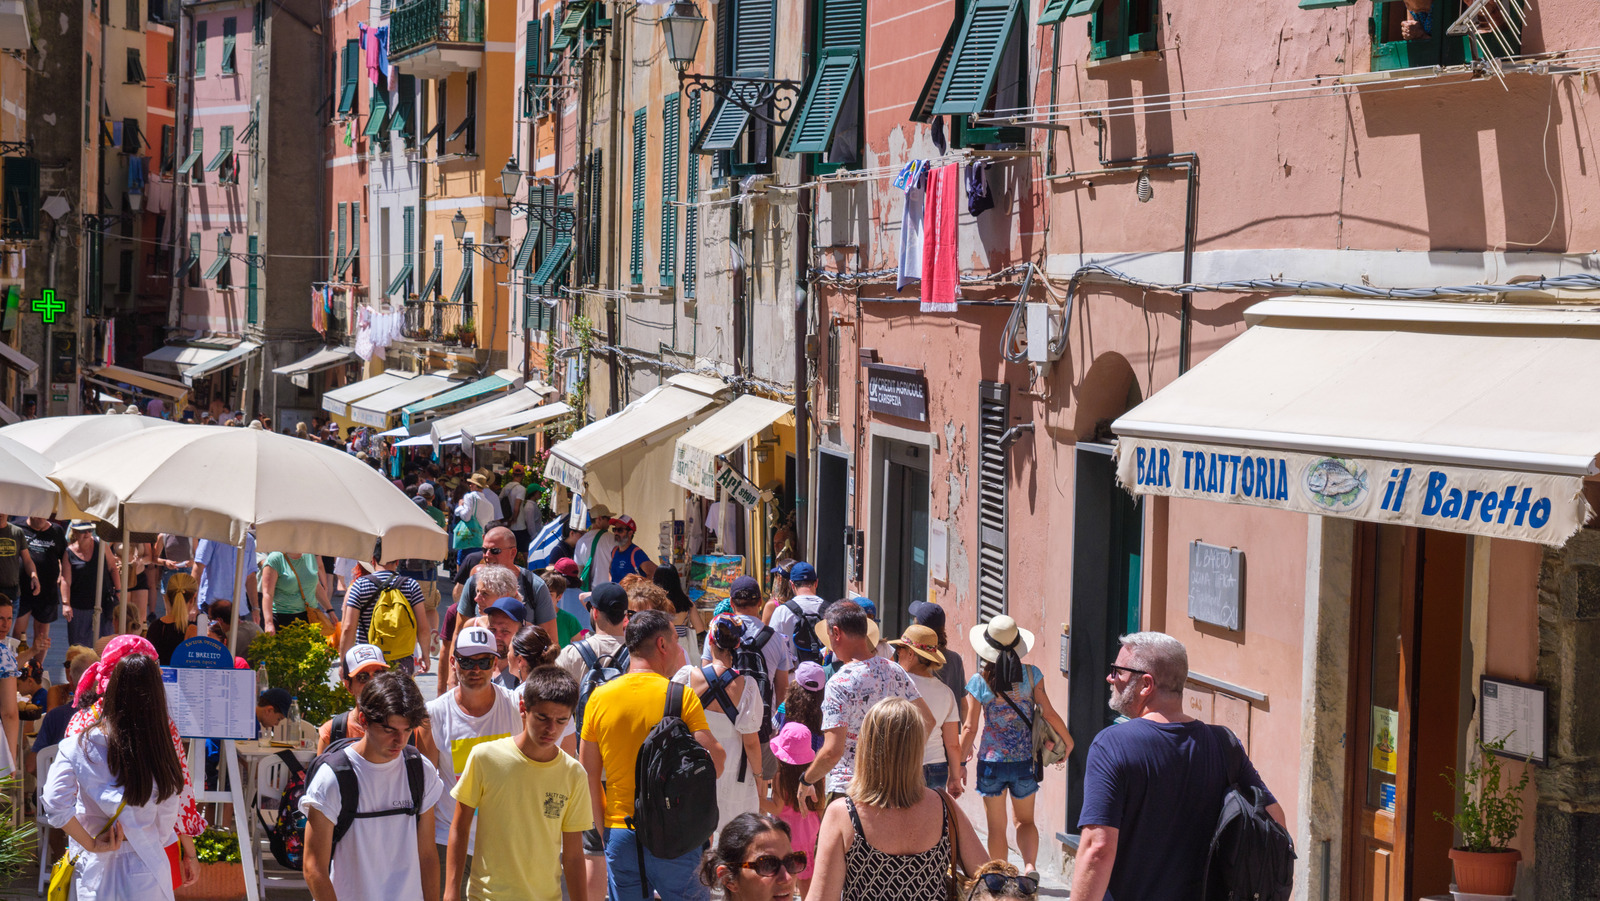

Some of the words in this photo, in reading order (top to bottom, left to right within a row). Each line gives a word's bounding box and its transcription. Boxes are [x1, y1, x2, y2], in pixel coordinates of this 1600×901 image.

[878, 393, 901, 406] CARISPEZIA
[896, 381, 923, 398] AGRICOLE
[717, 467, 742, 496] Art
[738, 487, 757, 505] shop
[1136, 446, 1171, 488] BAR
[1182, 450, 1288, 501] TRATTORIA
[1380, 467, 1412, 513] il
[1421, 470, 1551, 529] Baretto
[1190, 696, 1202, 711] GAS
